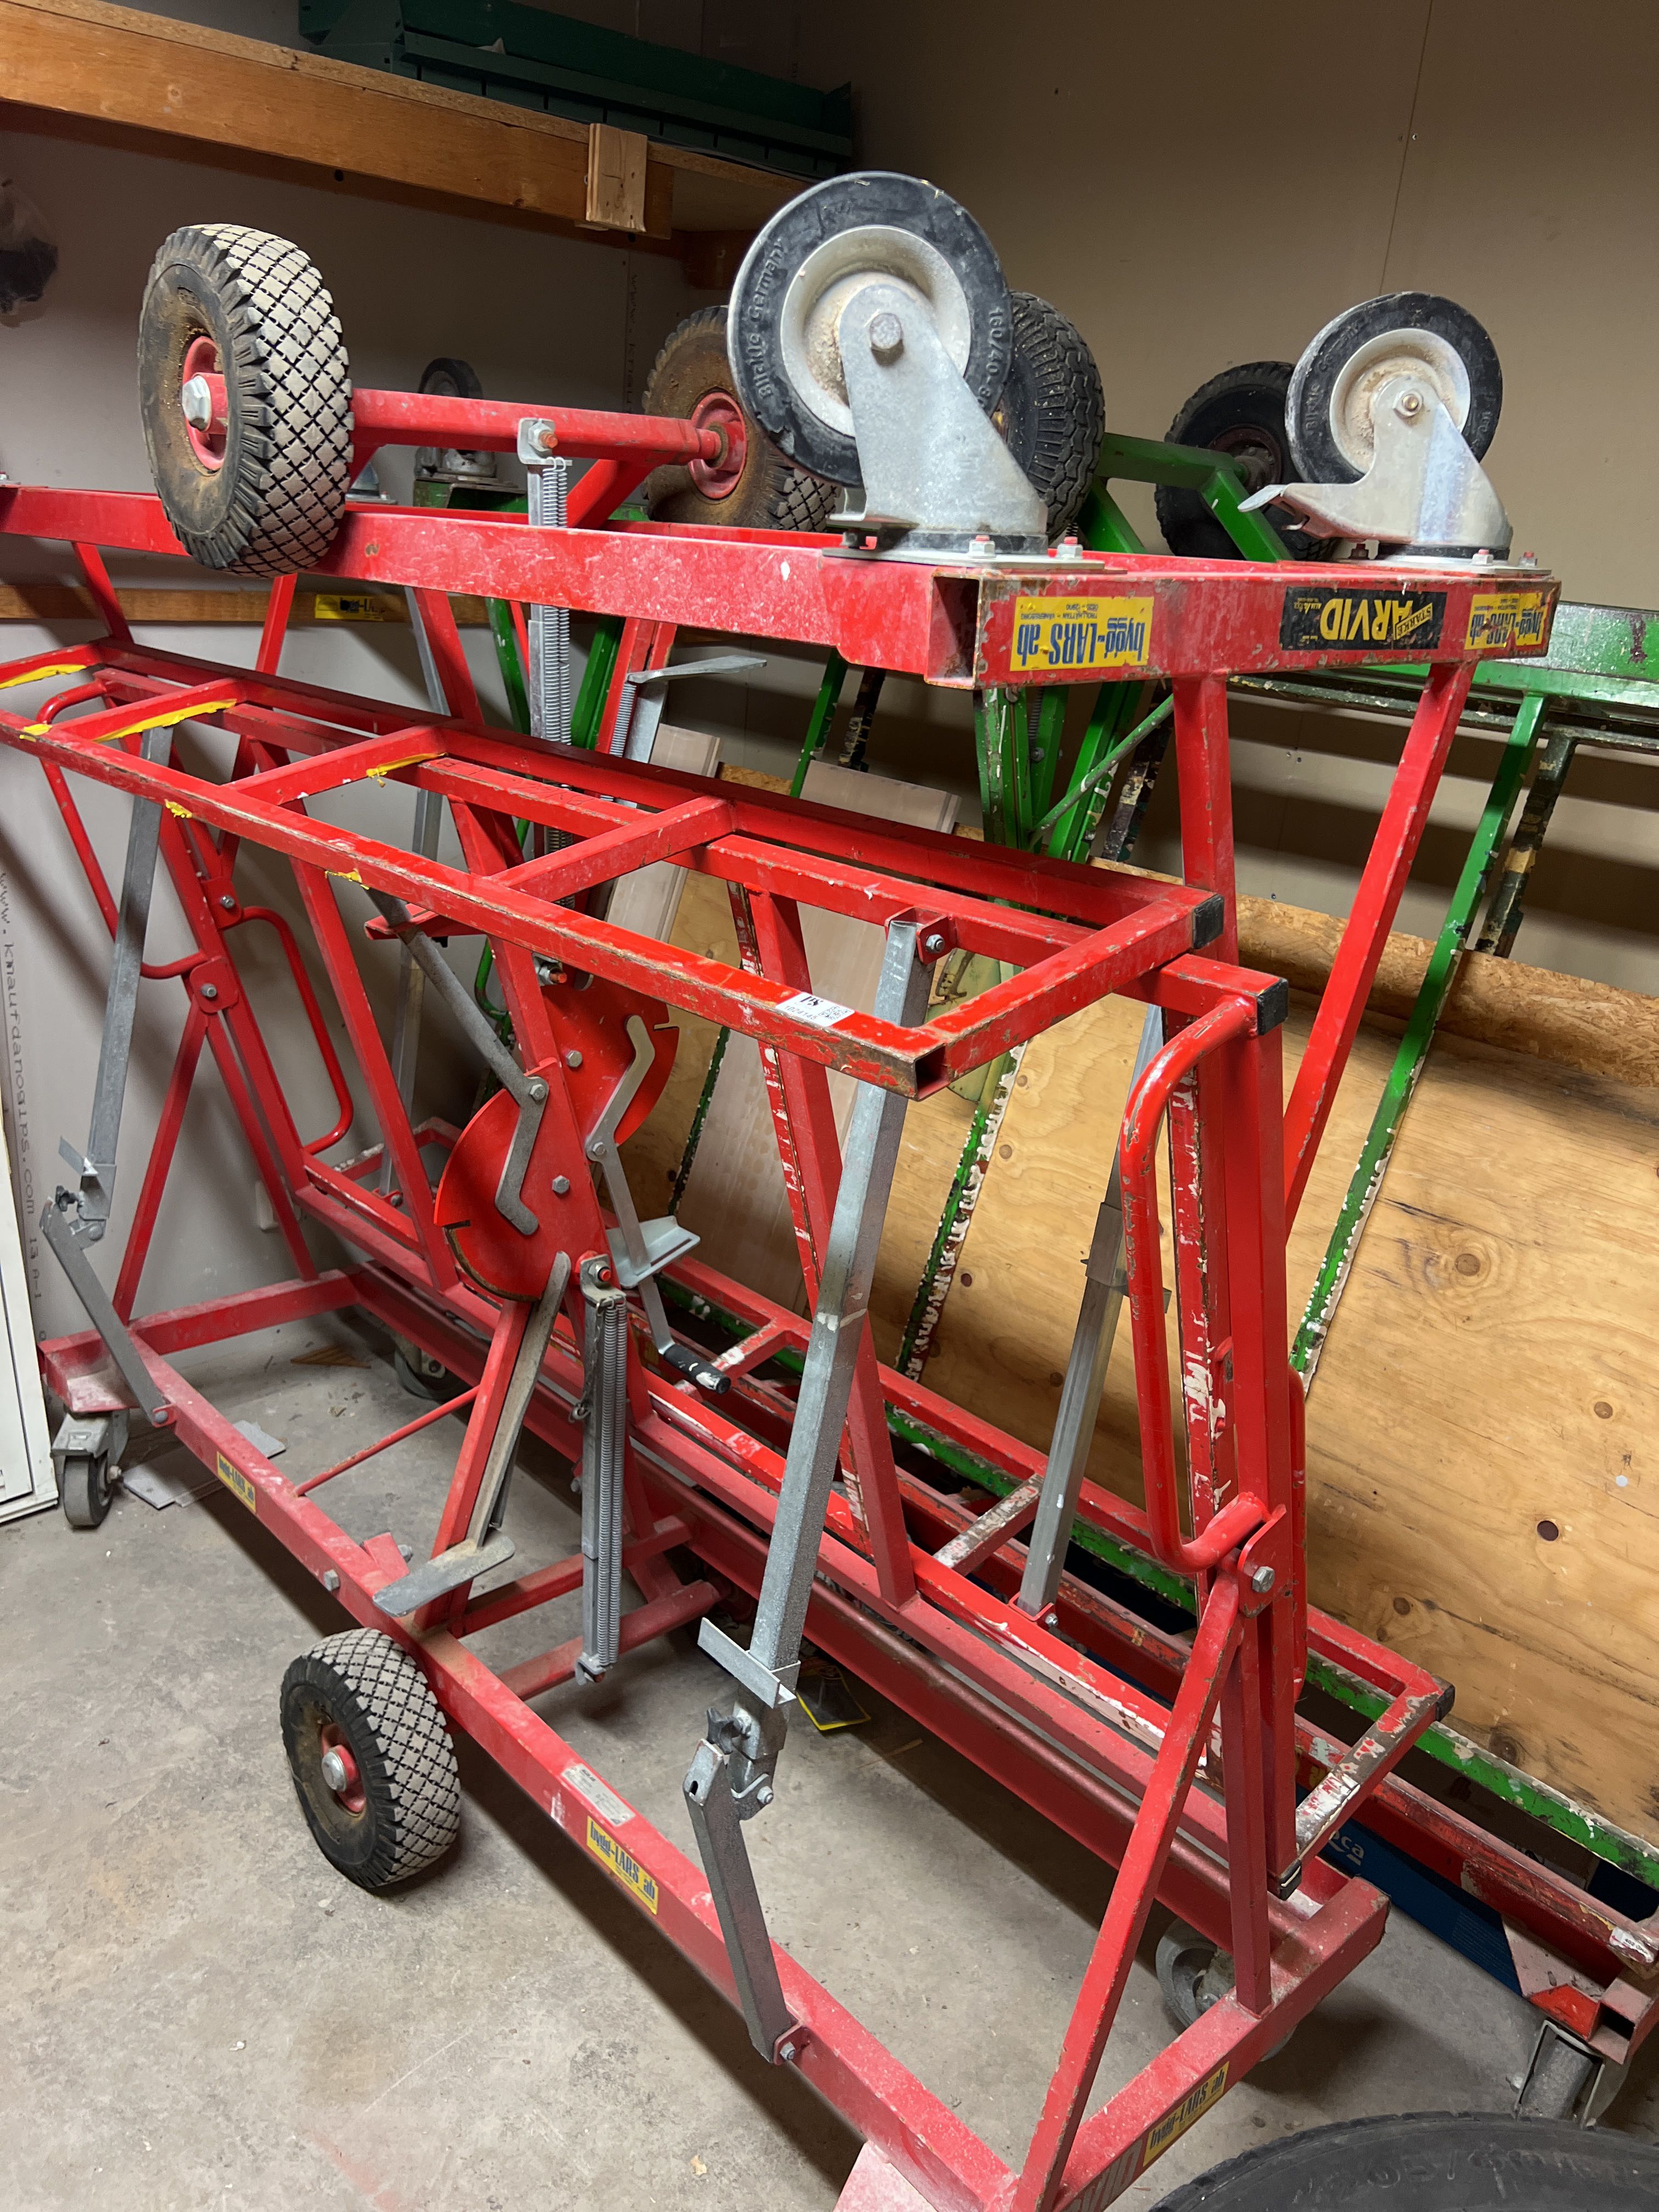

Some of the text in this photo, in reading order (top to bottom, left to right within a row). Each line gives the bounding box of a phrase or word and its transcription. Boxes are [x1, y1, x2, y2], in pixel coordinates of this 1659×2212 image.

[747, 239, 786, 323] Germany
[1017, 617, 1146, 667] bygg-LARS ab
[1319, 598, 1414, 640] ARVID
[1397, 606, 1433, 637] STARKE
